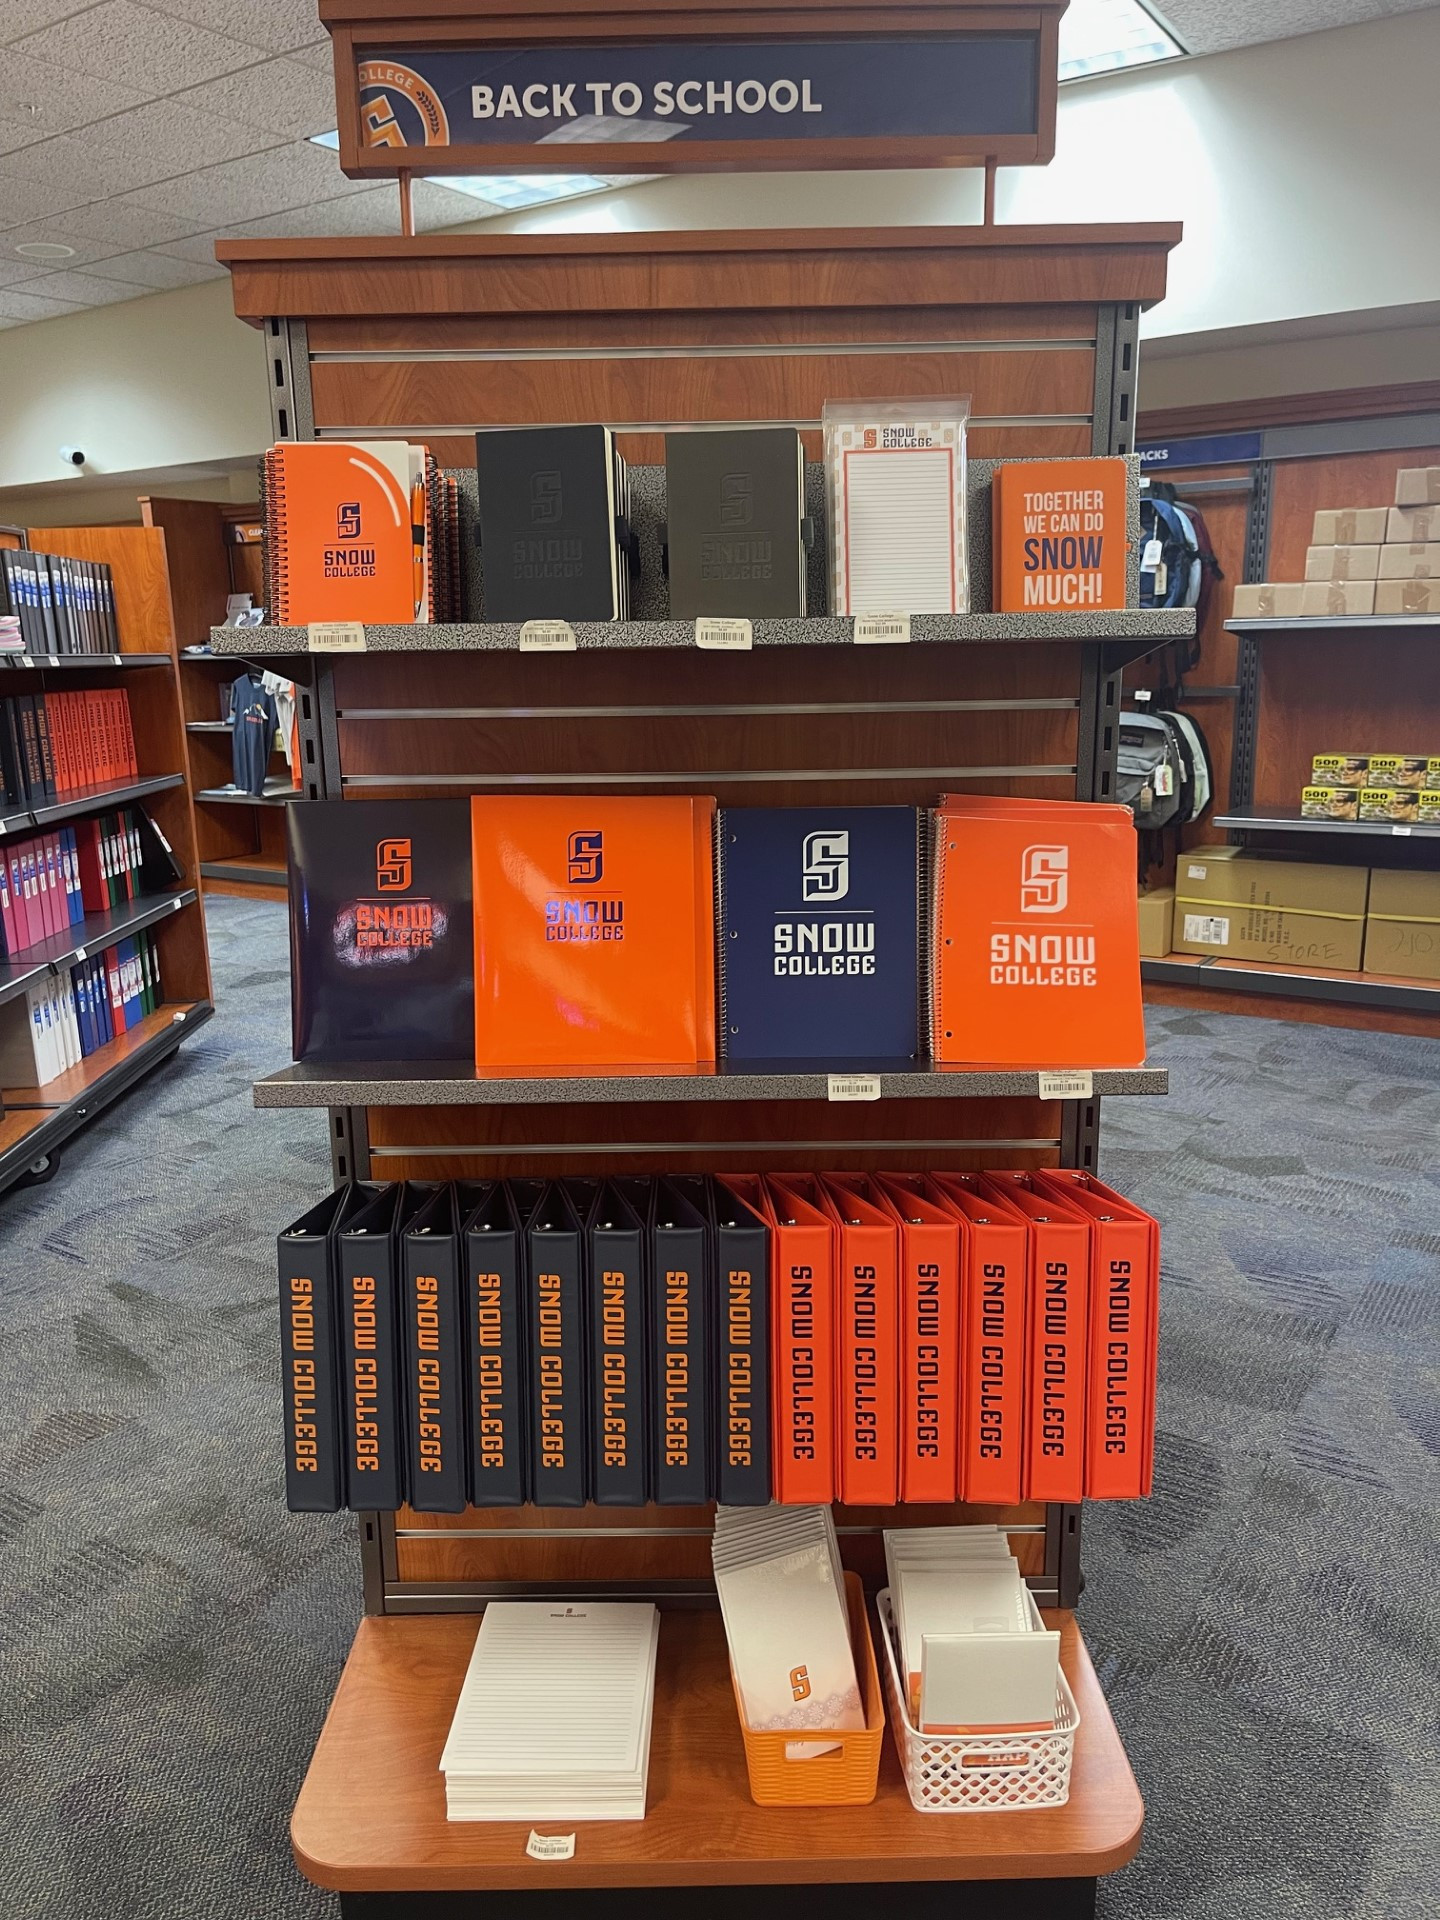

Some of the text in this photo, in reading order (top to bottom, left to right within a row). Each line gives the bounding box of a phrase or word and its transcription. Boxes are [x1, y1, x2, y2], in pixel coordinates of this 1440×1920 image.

[471, 79, 822, 118] BACK TO SCHOOL
[883, 428, 914, 438] SNOW
[883, 438, 932, 448] COLLEGE
[1023, 490, 1104, 513] TOGETHER
[1023, 512, 1104, 534] WE CAN DO
[324, 550, 375, 566] SNOW
[512, 539, 583, 562] SNOW
[701, 539, 772, 563] SNOW
[1023, 536, 1103, 571] SNOW
[324, 566, 376, 578] COLLEGE
[512, 563, 583, 579] COLLEGE
[701, 564, 772, 581] COLLEGE
[1023, 573, 1103, 606] MUCH!
[37, 709, 53, 781] SNOW COLLEGE
[356, 906, 432, 930] SNOW
[545, 901, 623, 924] SNOW
[356, 930, 433, 947] COLLEGE
[545, 925, 624, 942] COLLEGE
[774, 922, 874, 953] SNOW
[990, 934, 1095, 964] SNOW
[774, 955, 876, 975] COLLEGE
[1267, 943, 1342, 961] STORE
[990, 965, 1097, 986] COLLEGE
[478, 1273, 504, 1467] SNOW COLLEGE
[539, 1274, 564, 1468] SNOW COLLEGE
[603, 1271, 627, 1467] SNOW COLLEGE
[666, 1271, 688, 1466] SNOW COLLEGE
[729, 1271, 751, 1466] SNOW COLLEGE
[791, 1265, 815, 1460] SNOW COLLEGE
[854, 1265, 877, 1461] SNOW COLLEGE
[917, 1263, 939, 1458] SNOW COLLEGE
[980, 1264, 1005, 1459] SNOW COLLEGE
[1042, 1262, 1068, 1457] SNOW COLLEGE
[1105, 1260, 1131, 1454] SNOW COLLEGE
[291, 1278, 318, 1472] SNOW COLLEGE
[352, 1277, 379, 1471] SNOW COLLEGE
[416, 1276, 442, 1472] SNOW COLLEGE
[789, 1664, 811, 1702] S
